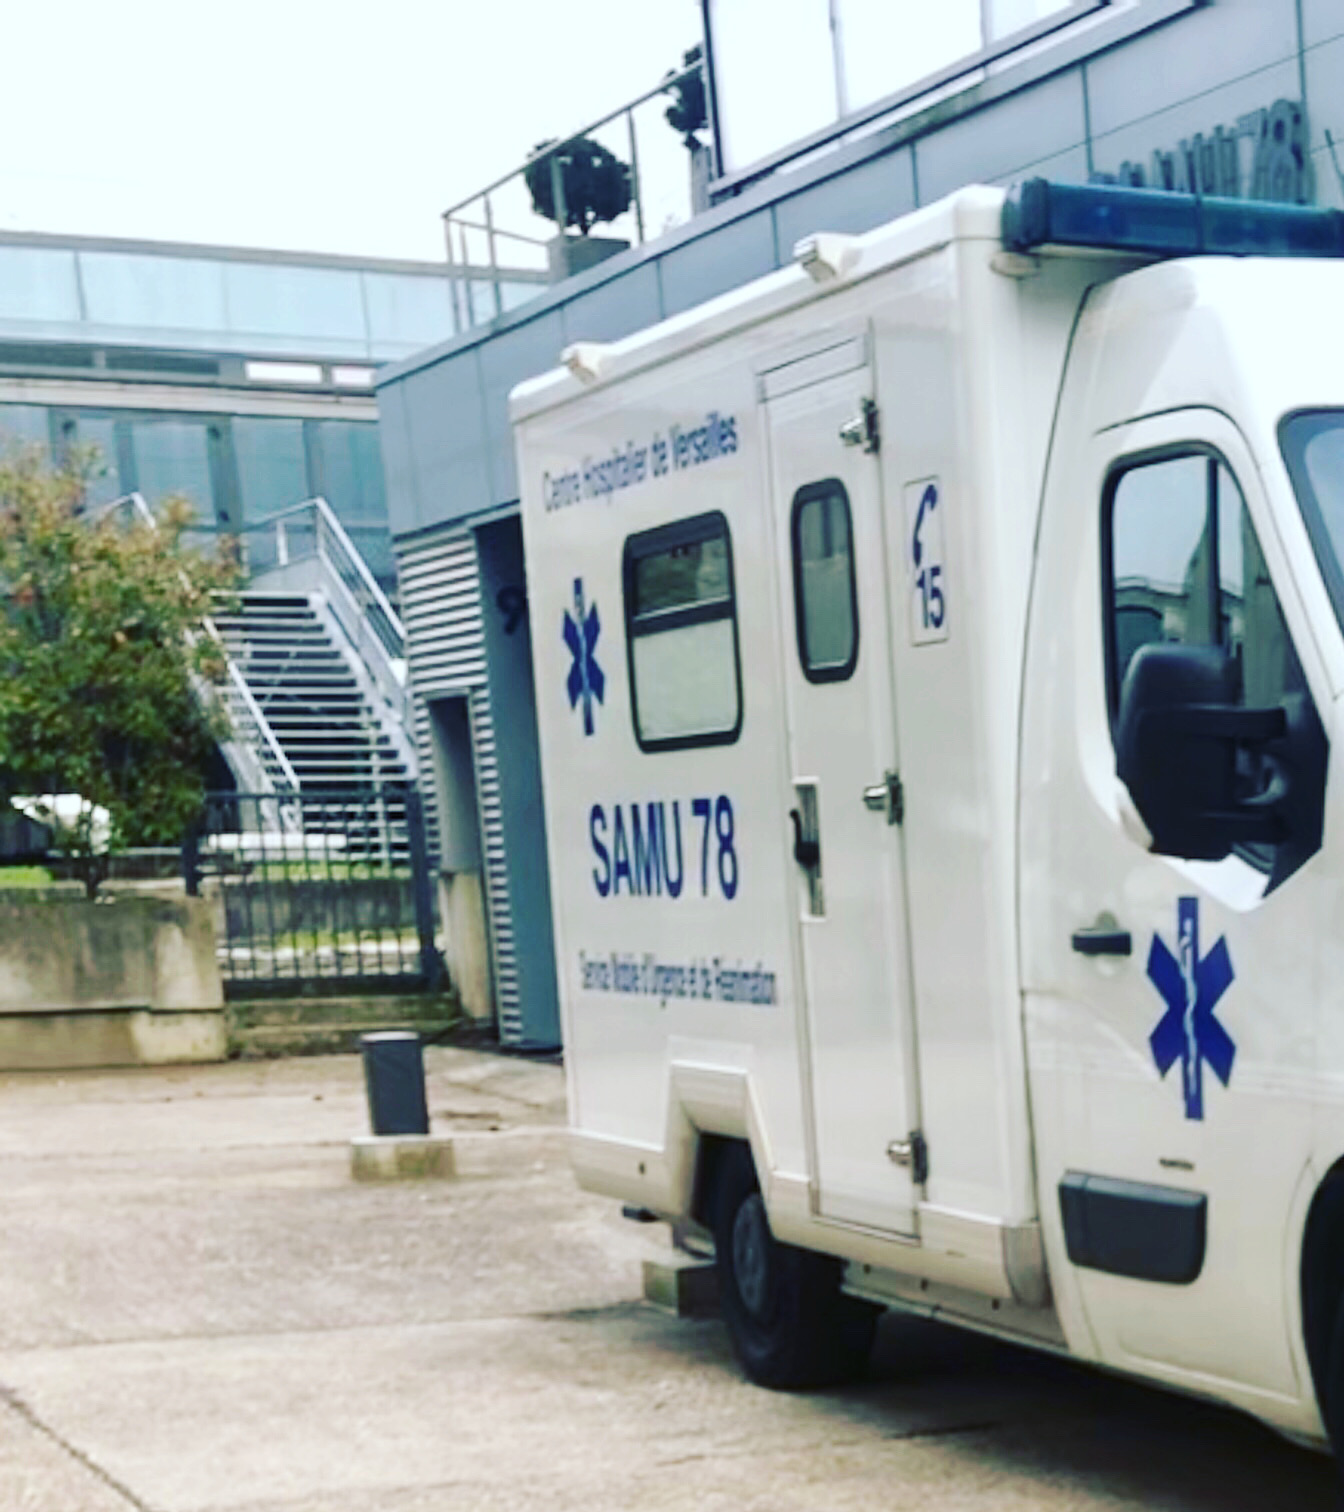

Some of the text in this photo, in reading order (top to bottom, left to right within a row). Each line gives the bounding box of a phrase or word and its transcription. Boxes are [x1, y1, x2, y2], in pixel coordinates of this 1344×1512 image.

[917, 566, 945, 629] 15
[589, 795, 739, 900] SAMU 78
